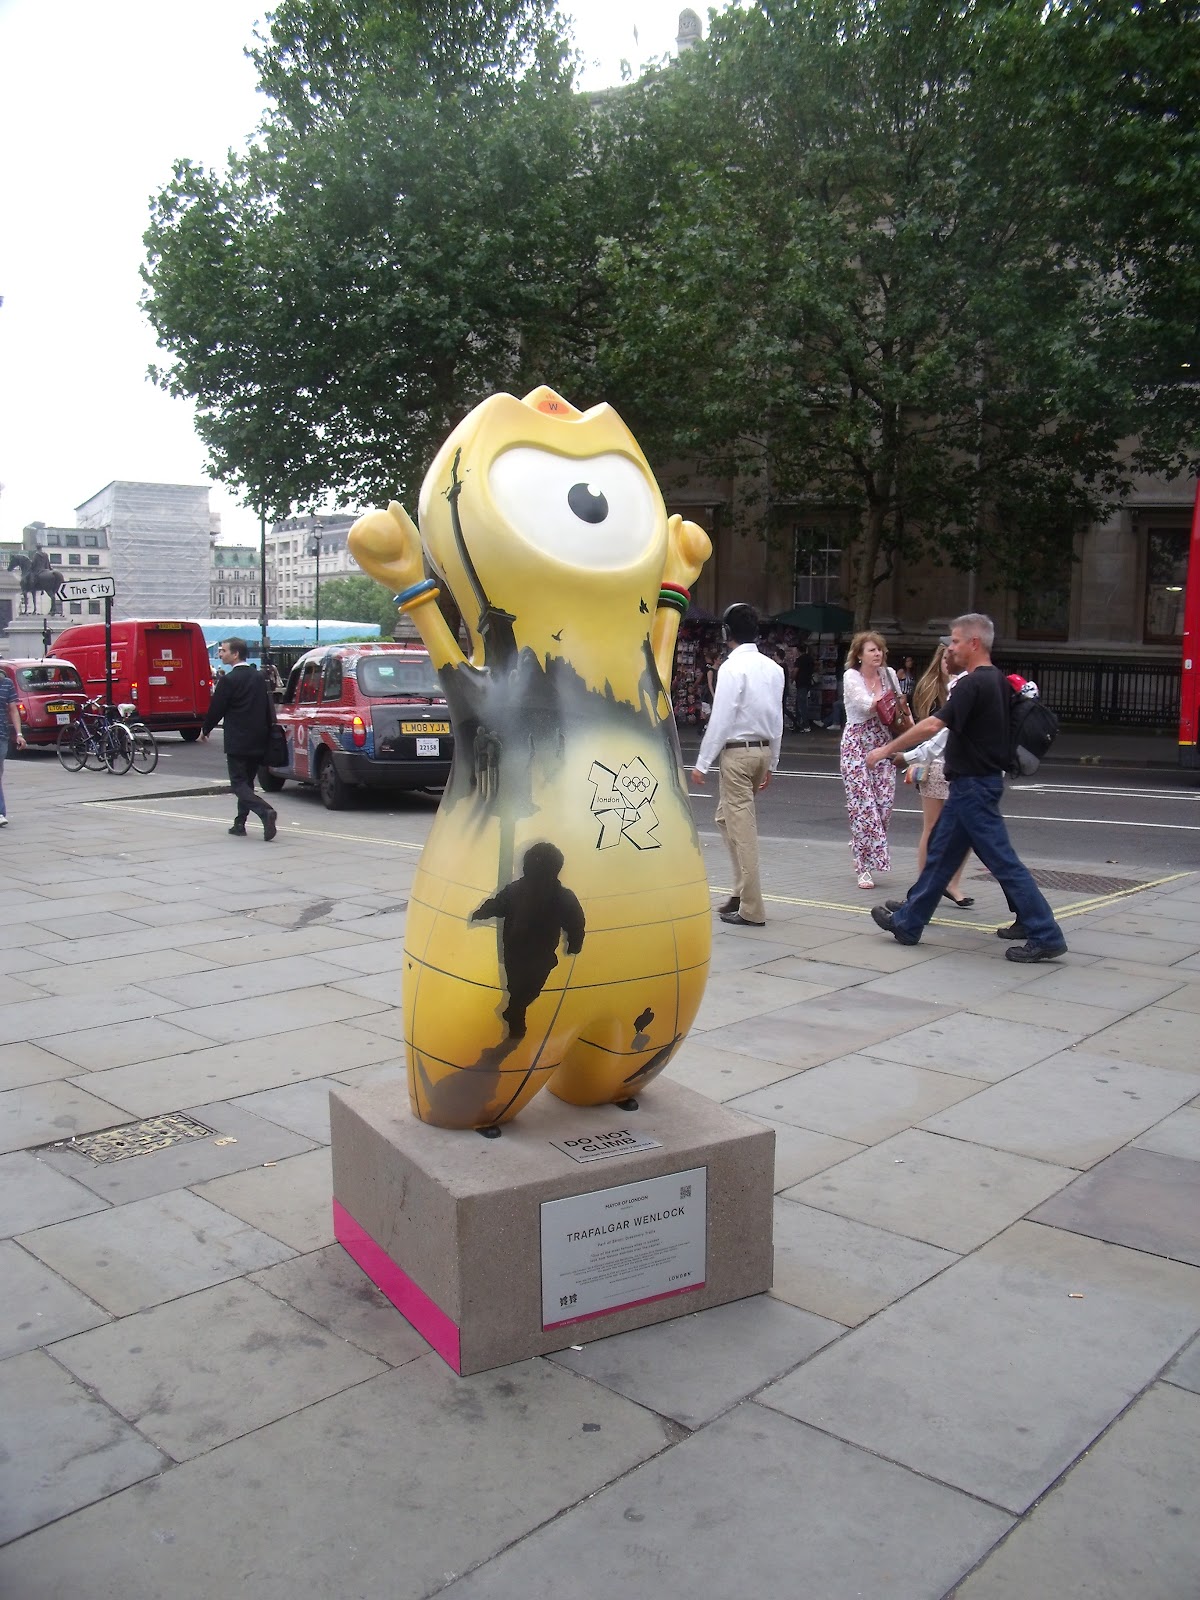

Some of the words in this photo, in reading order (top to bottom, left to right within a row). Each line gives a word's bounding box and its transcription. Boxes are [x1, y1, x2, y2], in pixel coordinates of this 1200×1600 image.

[548, 402, 558, 411] W
[69, 586, 88, 595] The
[90, 584, 110, 594] City
[405, 723, 428, 732] LM08
[430, 723, 446, 732] YJA
[563, 1137, 592, 1148] DO
[594, 1129, 632, 1141] NOT
[581, 1138, 637, 1152] CLIMB
[605, 1201, 621, 1209] MAYOR
[628, 1195, 649, 1204] LONDON
[567, 1220, 630, 1243] TRAFALGAR
[633, 1206, 686, 1227] WENLOCK
